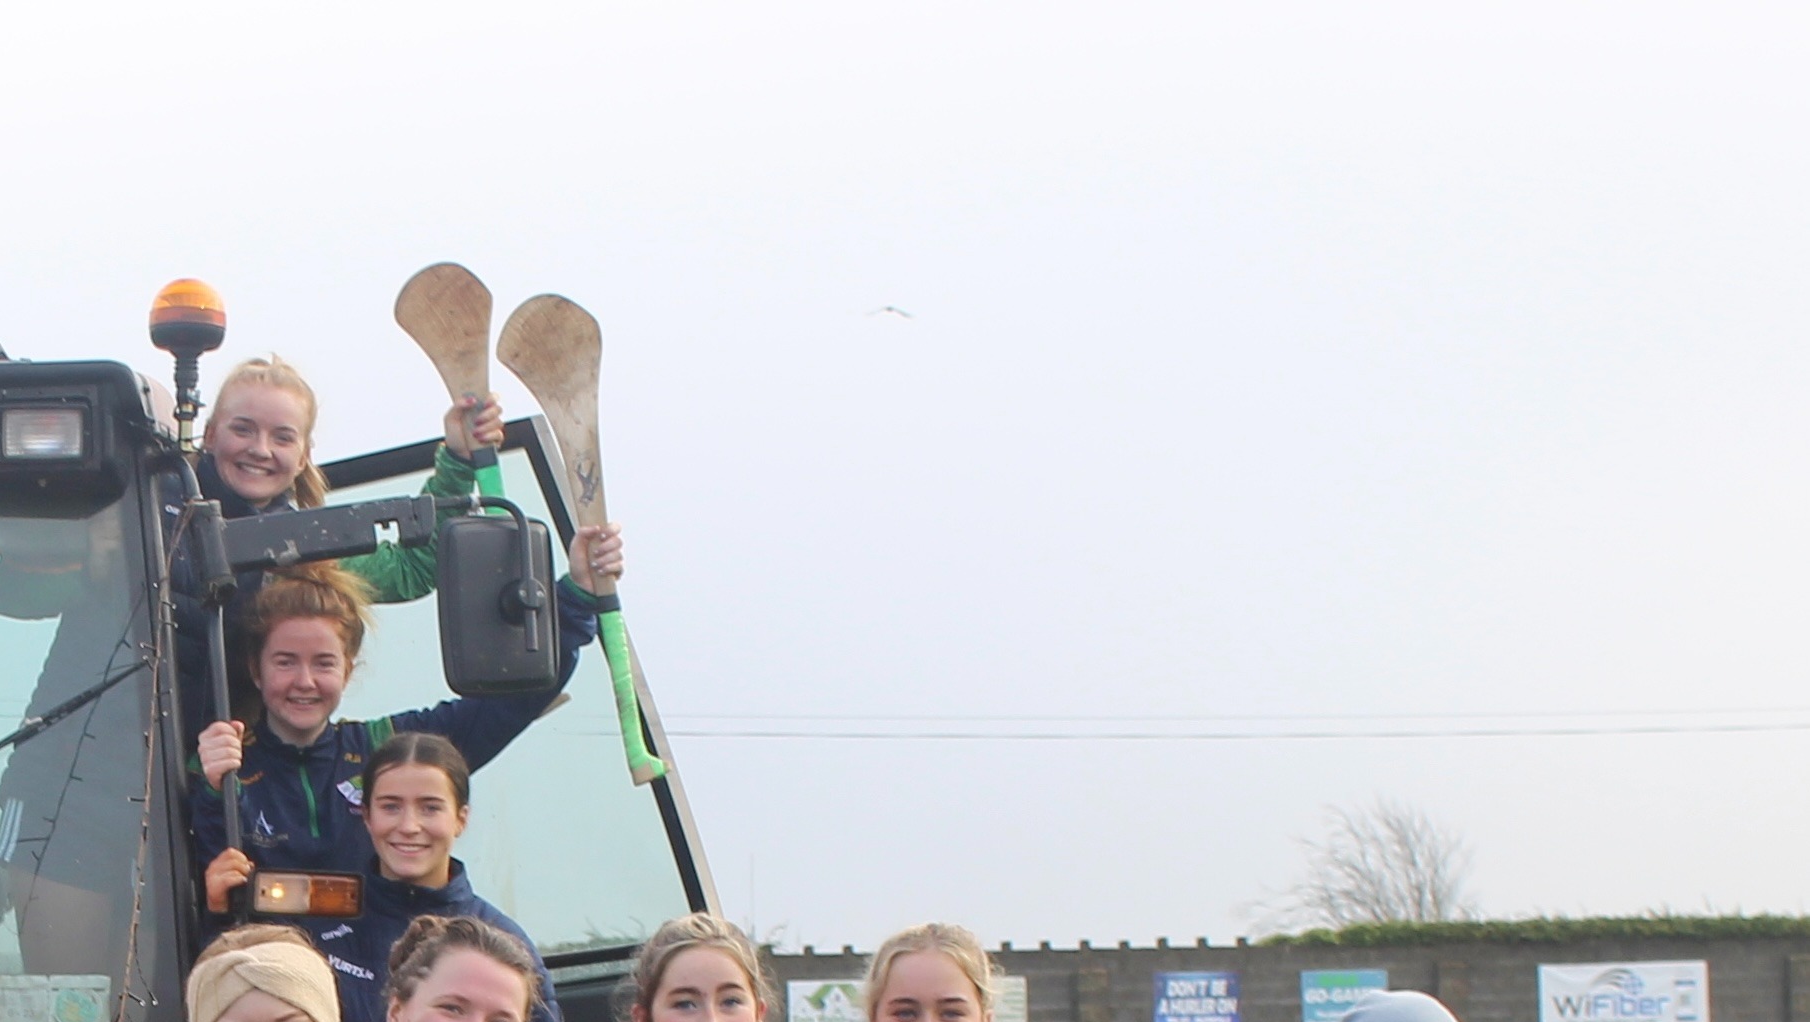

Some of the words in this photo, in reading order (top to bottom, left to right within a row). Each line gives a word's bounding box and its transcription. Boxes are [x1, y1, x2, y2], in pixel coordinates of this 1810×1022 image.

[1166, 980, 1208, 997] DON'T
[1211, 980, 1228, 997] BE
[1158, 998, 1170, 1015] A
[1171, 999, 1216, 1015] HURLER
[1217, 998, 1238, 1015] ON
[1552, 994, 1670, 1018] WiFiber
